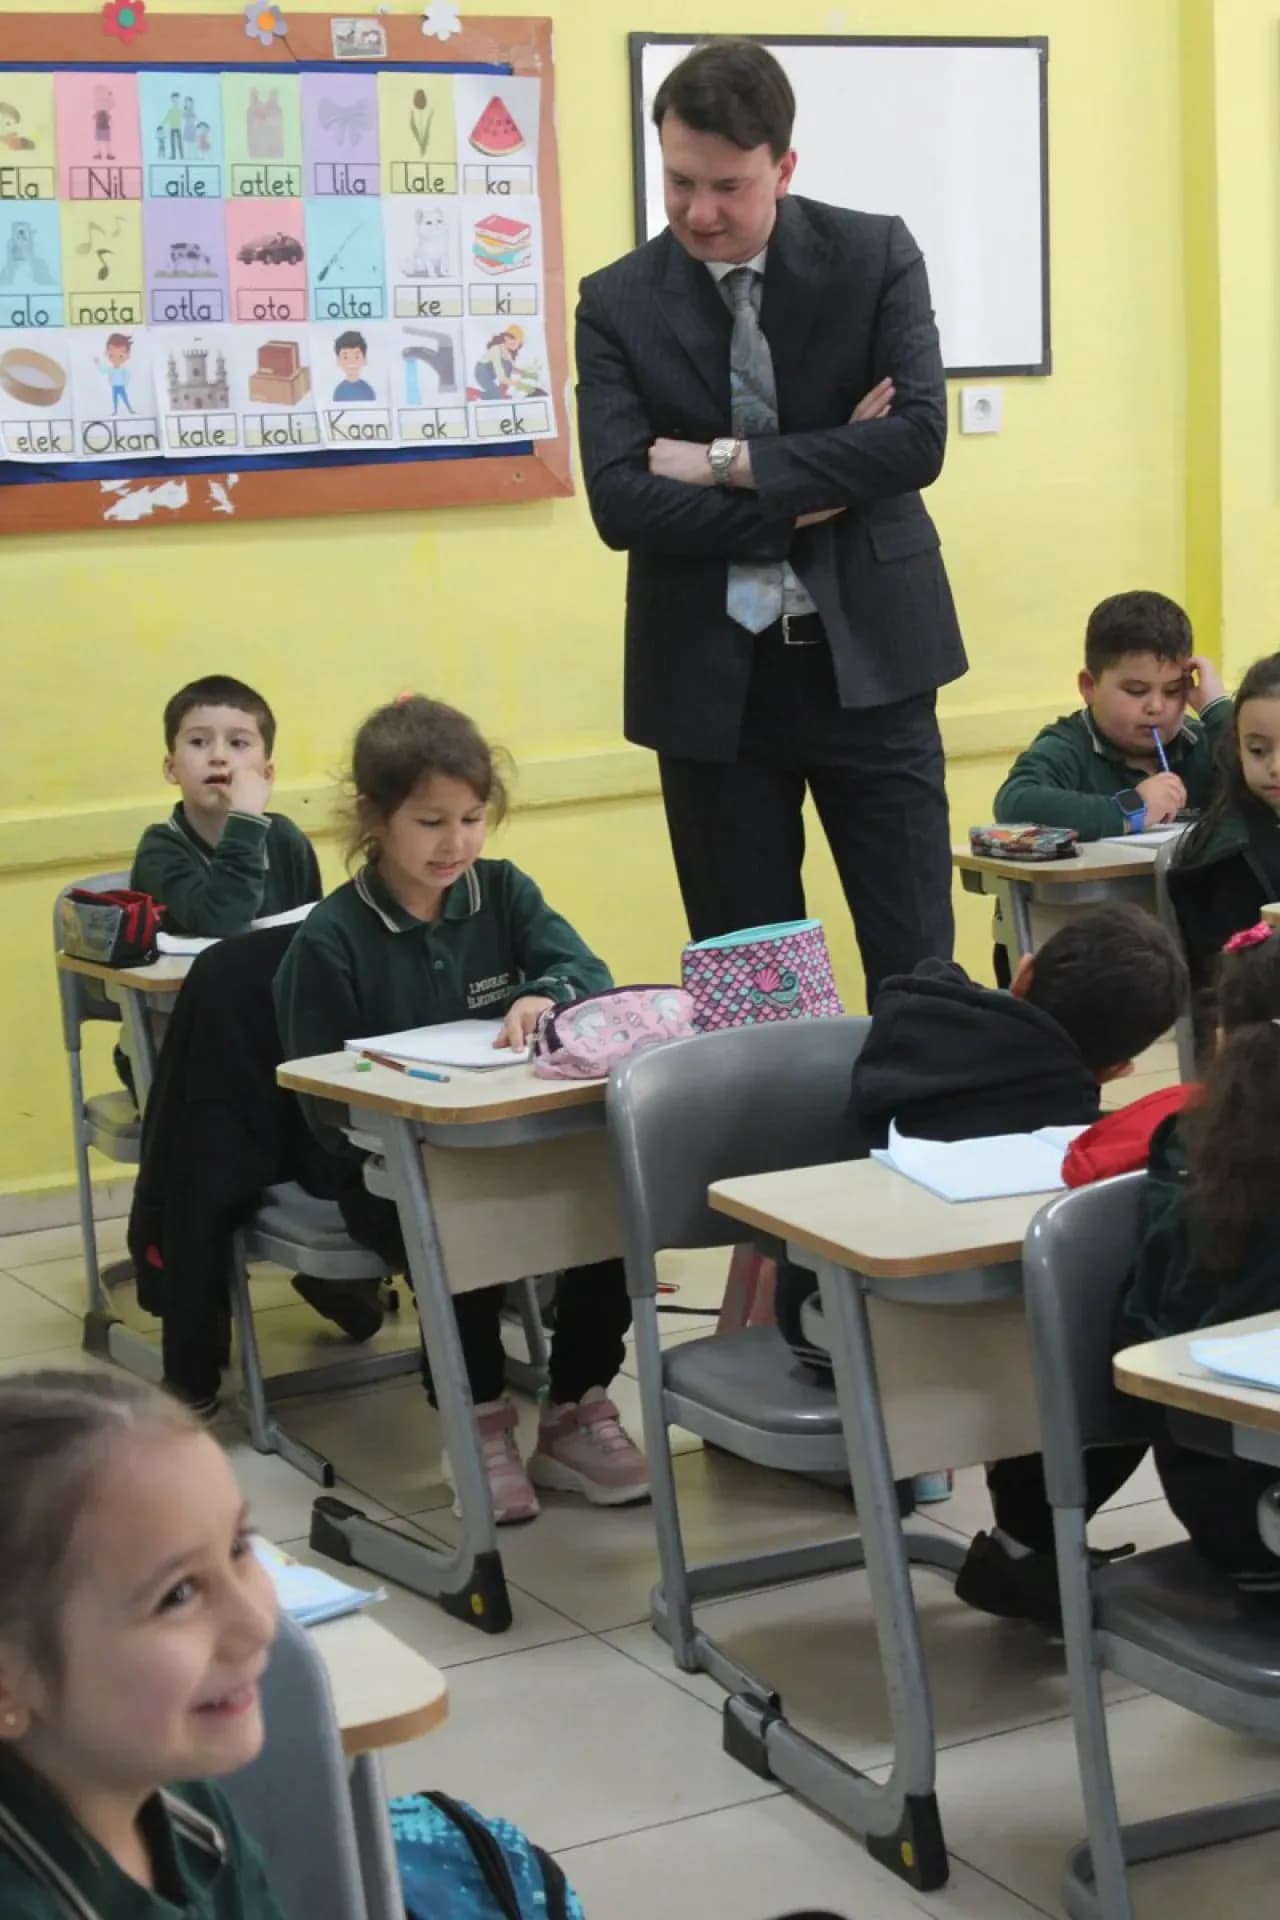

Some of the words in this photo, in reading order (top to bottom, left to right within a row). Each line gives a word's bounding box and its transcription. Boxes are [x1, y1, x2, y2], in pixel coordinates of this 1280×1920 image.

[0, 167, 39, 199] Ela
[88, 166, 126, 199] Nil
[165, 165, 206, 197] aile
[240, 165, 294, 196] atlet
[332, 163, 367, 194] lila
[404, 162, 445, 193] lale
[485, 165, 511, 195] ka
[11, 294, 49, 327] alo
[79, 299, 134, 324] nota
[164, 290, 211, 321] otla
[253, 296, 290, 321] oto
[327, 287, 372, 318] olta
[417, 285, 441, 316] ke
[495, 284, 512, 314] ki
[177, 415, 226, 447] kale
[260, 413, 303, 446] koli
[327, 410, 389, 440] Kaan
[421, 408, 448, 439] ak
[500, 404, 526, 435] ek
[16, 420, 60, 452] elek
[83, 419, 160, 452] Okan
